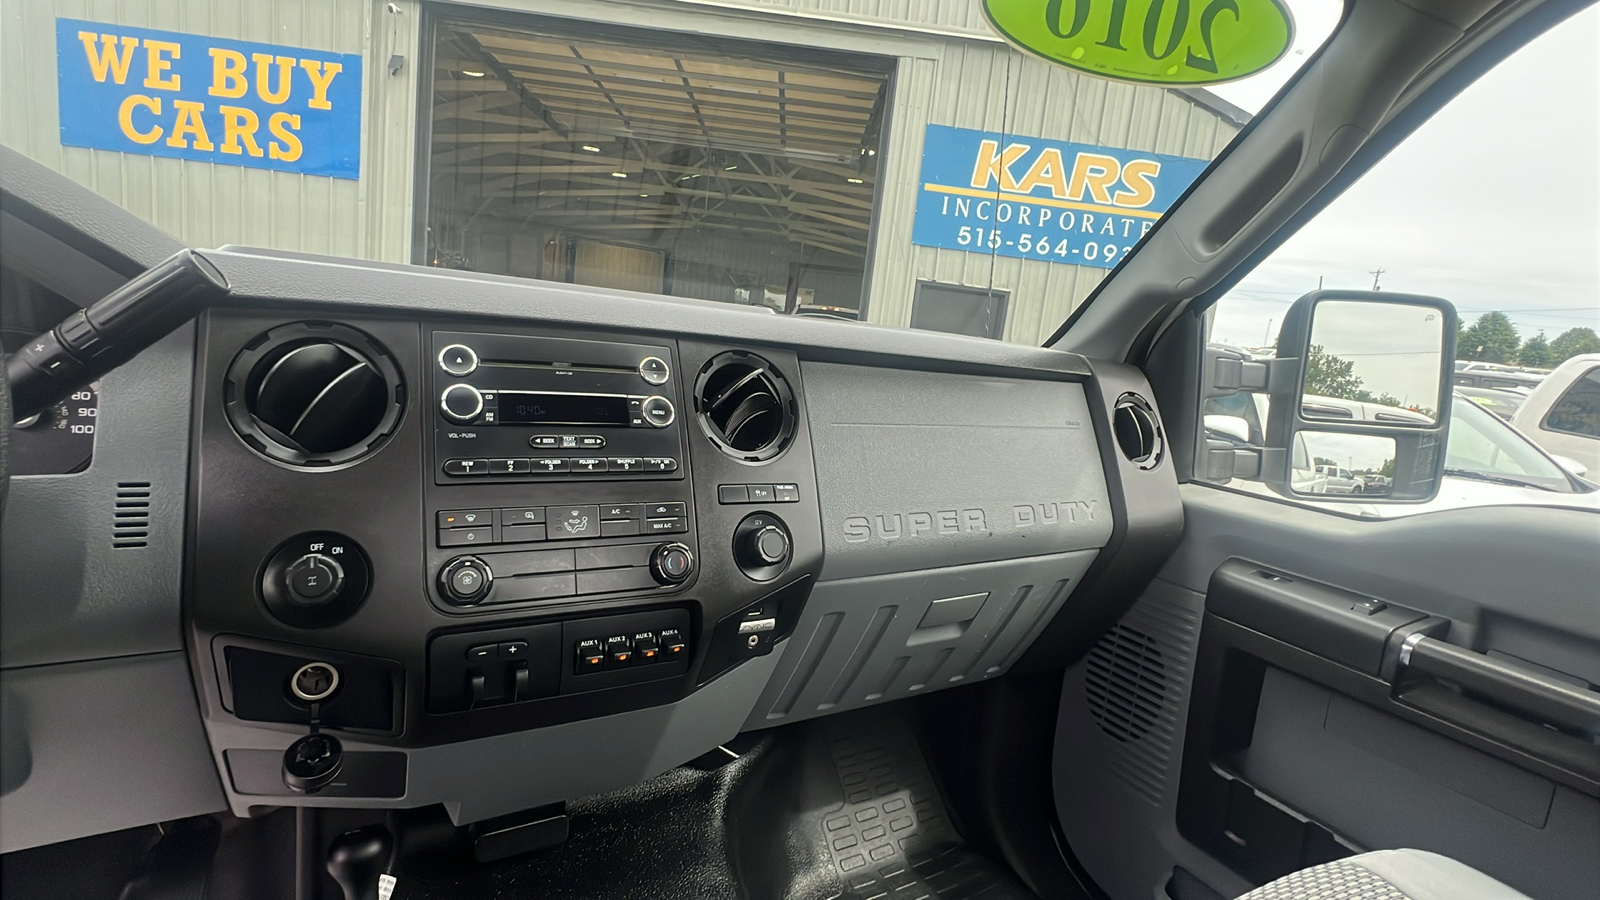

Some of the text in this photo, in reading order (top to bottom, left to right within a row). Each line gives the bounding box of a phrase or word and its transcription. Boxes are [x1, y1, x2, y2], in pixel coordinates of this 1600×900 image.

[78, 31, 342, 110] WE BUY
[118, 94, 303, 162] CARS
[970, 139, 1161, 208] KARS
[78, 407, 98, 417] 90
[70, 424, 95, 434] 100
[843, 499, 1098, 543] SUPER DUTY
[310, 543, 325, 551] OFF
[331, 546, 344, 555] ON
